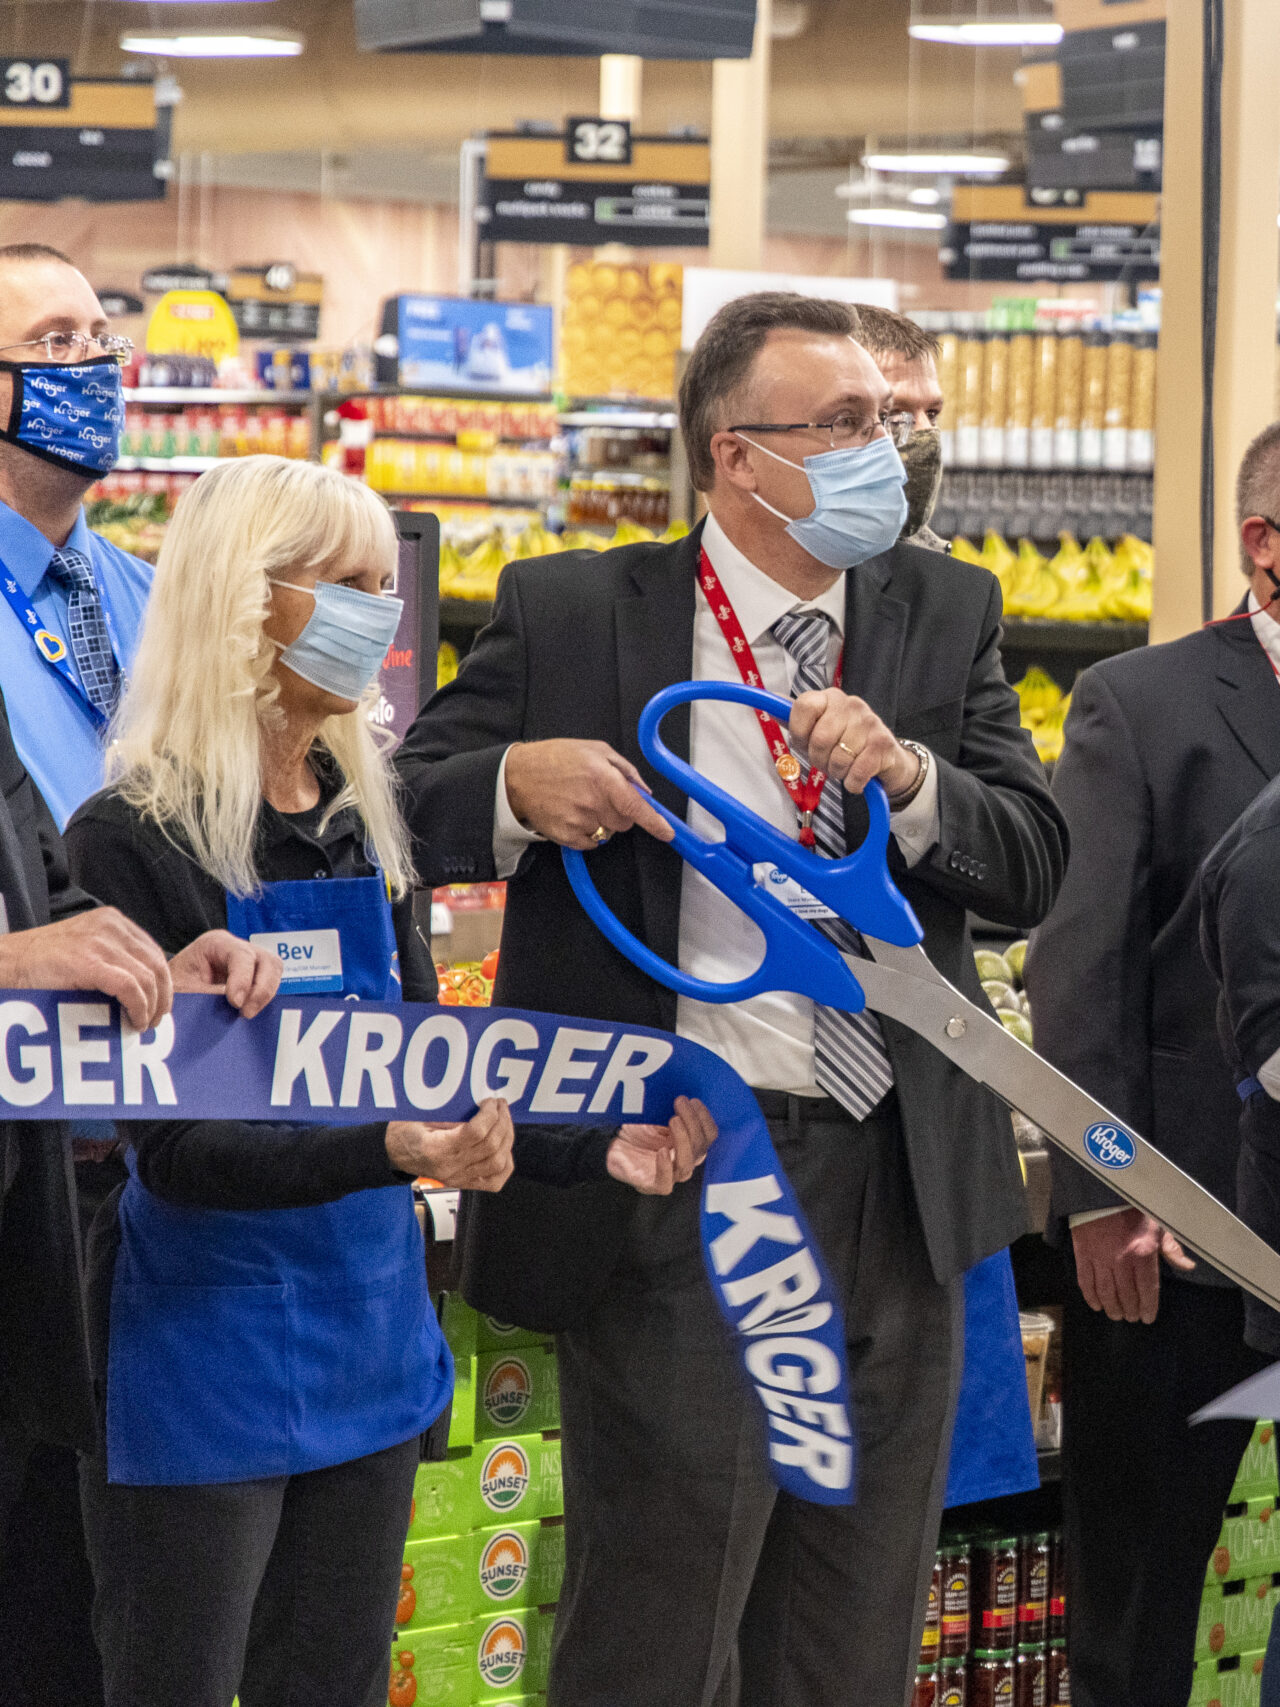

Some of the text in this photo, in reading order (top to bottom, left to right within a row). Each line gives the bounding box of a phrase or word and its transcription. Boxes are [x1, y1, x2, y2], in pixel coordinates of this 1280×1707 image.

[5, 62, 62, 102] 30
[574, 122, 627, 160] 32
[31, 377, 68, 397] Kroger
[82, 382, 118, 403] Kroger
[54, 401, 91, 422] Kroger
[27, 418, 64, 438] Kroger
[78, 427, 112, 448] Kroger
[47, 444, 85, 460] Kroger
[277, 942, 314, 960] Bev
[0, 1001, 673, 1115] GER KROGER
[1091, 1127, 1131, 1163] Kroger
[705, 1174, 853, 1489] KROGER
[484, 1392, 531, 1411] SUNSET
[481, 1476, 528, 1496] SUNSET
[480, 1564, 527, 1584] SUNSET
[479, 1652, 526, 1672] SUNSET
